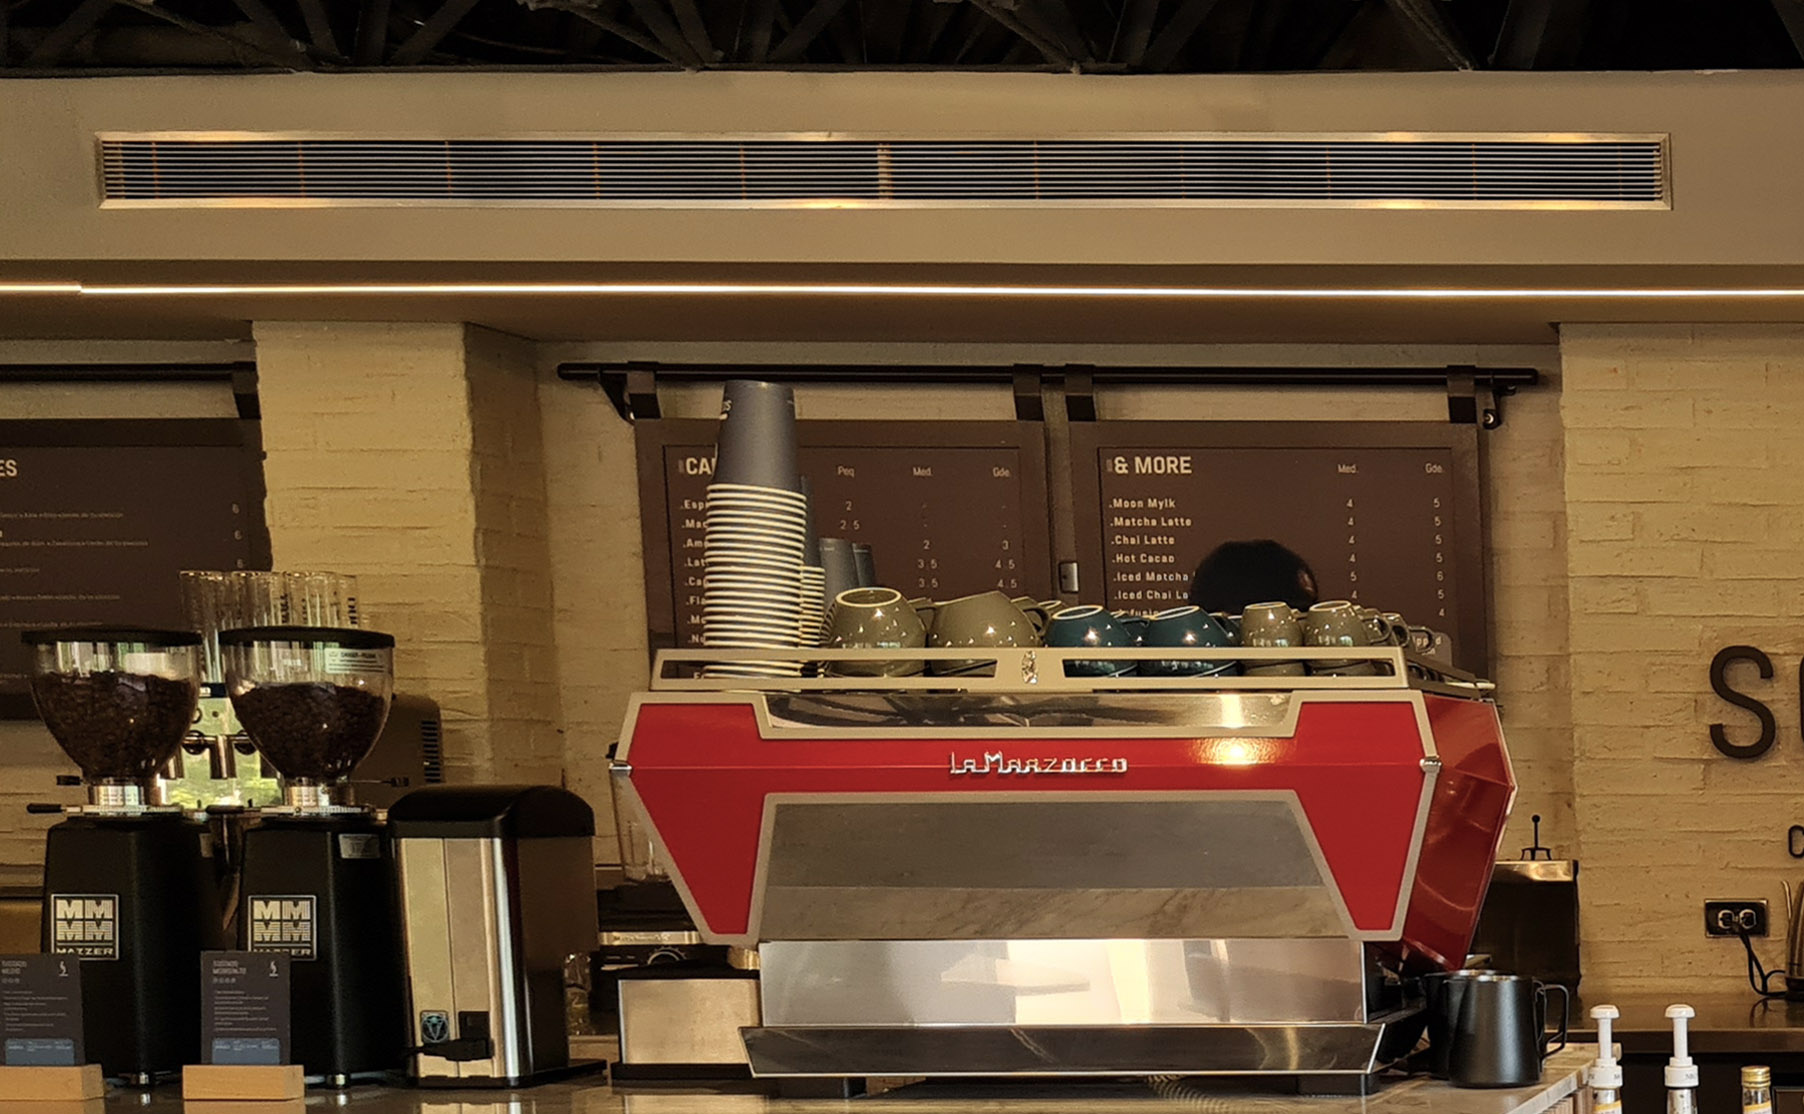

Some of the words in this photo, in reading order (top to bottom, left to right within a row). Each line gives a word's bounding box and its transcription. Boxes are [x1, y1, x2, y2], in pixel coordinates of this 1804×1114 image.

[1113, 456, 1129, 474] &
[1134, 456, 1192, 474] MORE
[1147, 498, 1176, 510] Mylk
[1346, 498, 1354, 508] 4
[1433, 497, 1440, 508] 5
[1161, 517, 1192, 527] Latte
[1347, 516, 1354, 526] 4
[1434, 516, 1441, 526] 5
[1144, 535, 1175, 545] Latte
[1435, 534, 1442, 545] 5
[923, 540, 930, 550] 2
[1002, 540, 1009, 550] 3
[1140, 553, 1175, 563] Cacao
[1349, 553, 1356, 563] 4
[1436, 552, 1443, 563] 5
[1146, 571, 1189, 581] Matcha
[1350, 571, 1357, 581] 5
[1436, 570, 1444, 581] 6
[1146, 590, 1172, 600] Chai
[1351, 589, 1358, 600] 4
[1437, 589, 1445, 599] 5
[1438, 608, 1445, 617] 4
